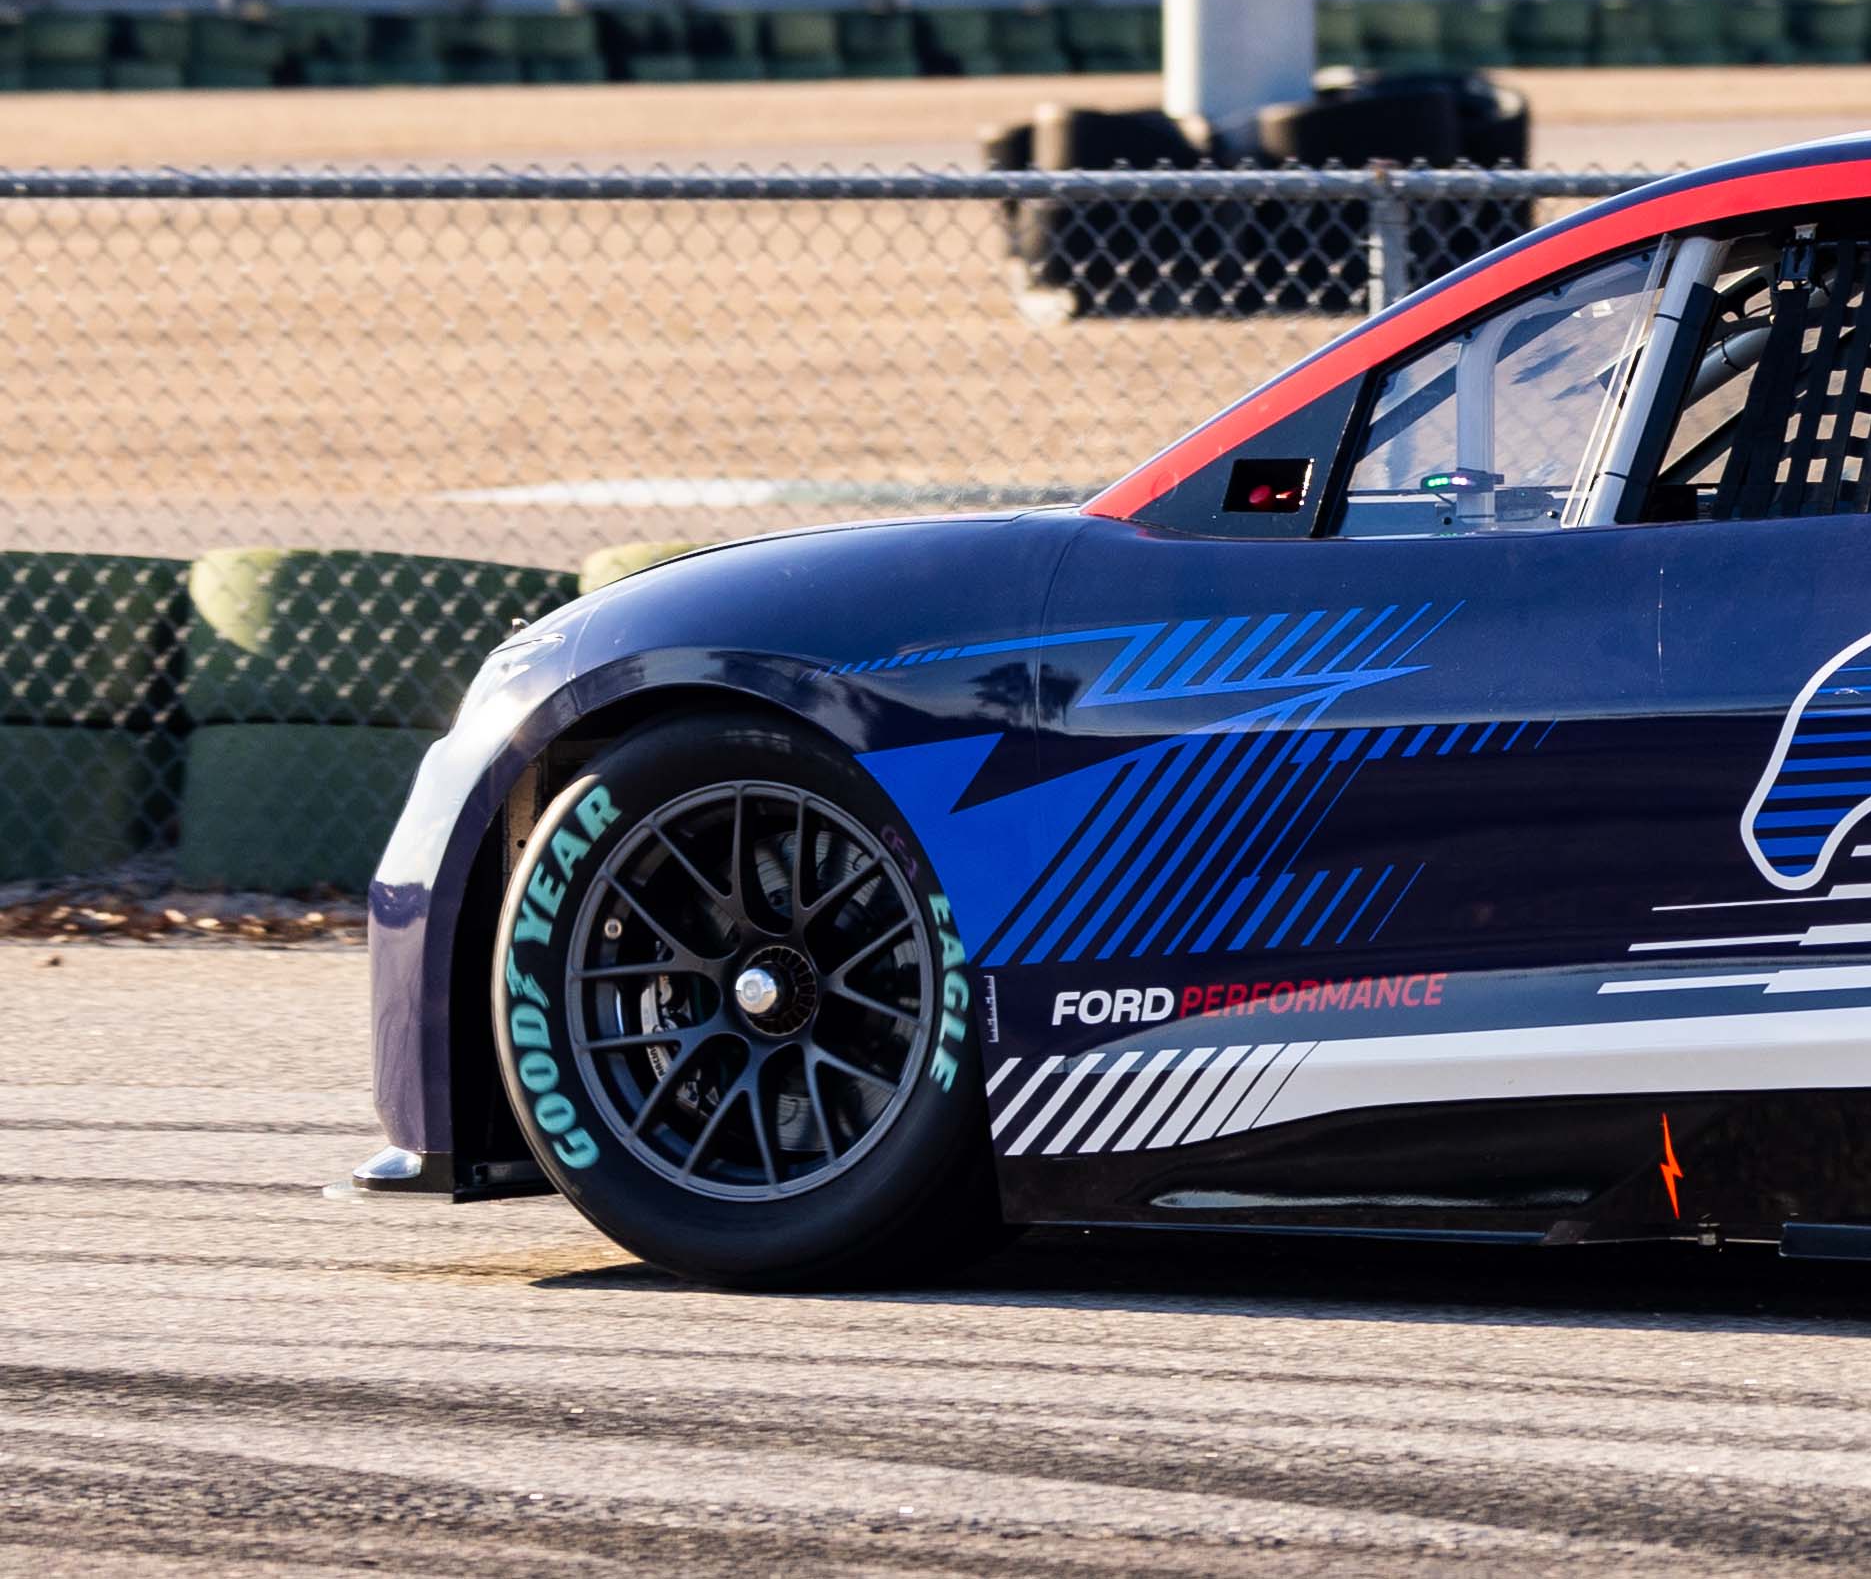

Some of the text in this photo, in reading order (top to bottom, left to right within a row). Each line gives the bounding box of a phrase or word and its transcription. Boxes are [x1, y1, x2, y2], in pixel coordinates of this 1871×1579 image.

[928, 891, 971, 1095] EAGLE
[1051, 972, 1448, 1027] FORD PERFORMANCE
